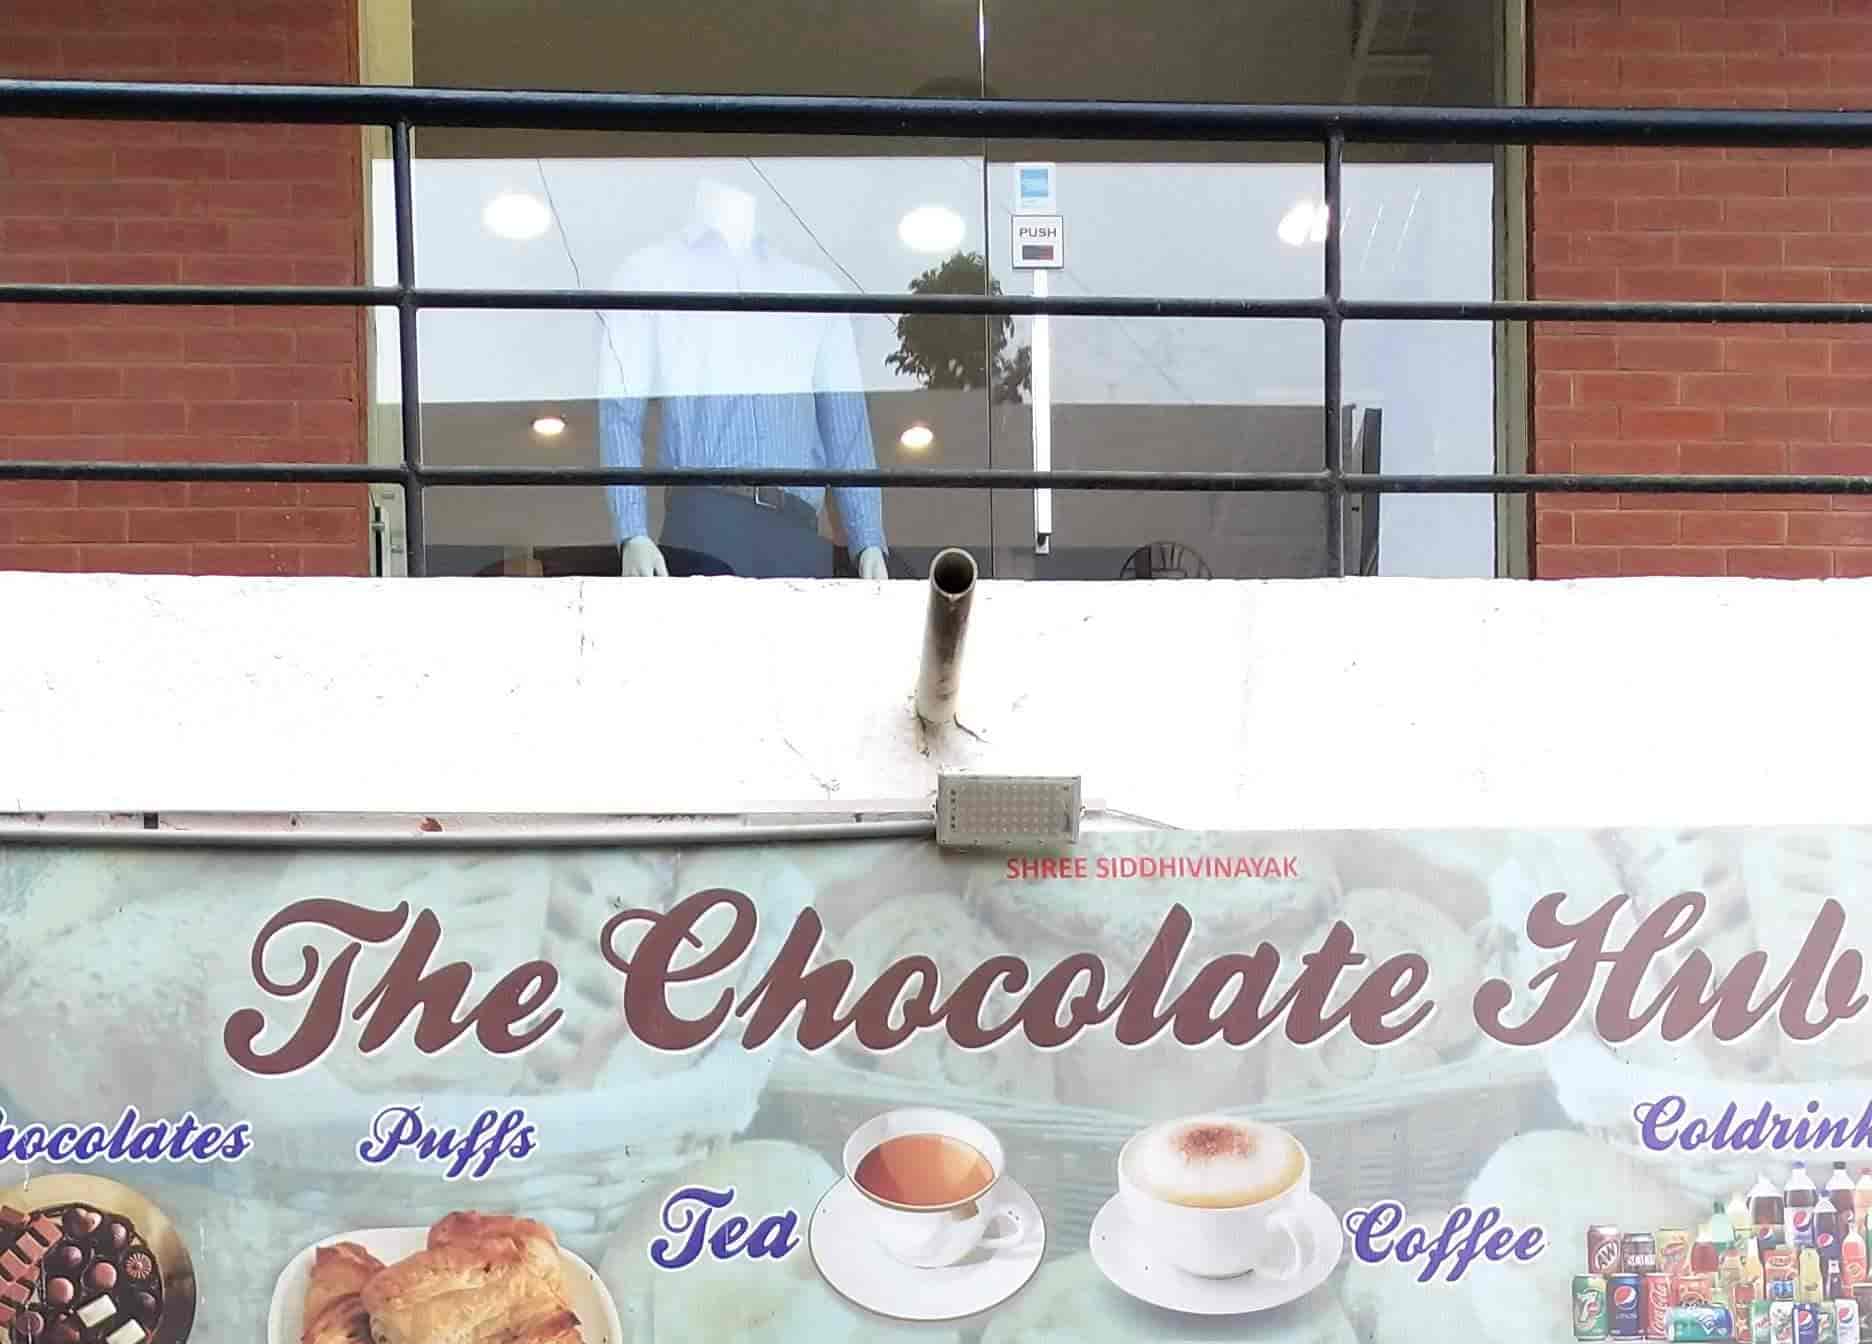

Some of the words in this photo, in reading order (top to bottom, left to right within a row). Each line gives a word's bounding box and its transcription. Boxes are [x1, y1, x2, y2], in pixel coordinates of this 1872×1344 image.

[1018, 226, 1057, 238] PUSH
[1006, 857, 1088, 880] SHREE
[1095, 856, 1299, 880] SIDDHIVINAYAK
[223, 896, 564, 1076] The
[600, 887, 1436, 1053] Chocolate
[1474, 890, 1870, 1046] Hub
[0, 1107, 252, 1162] hocolates
[359, 1106, 537, 1178] Puffs
[650, 1187, 800, 1268] Tea
[1345, 1202, 1545, 1282] Coffee
